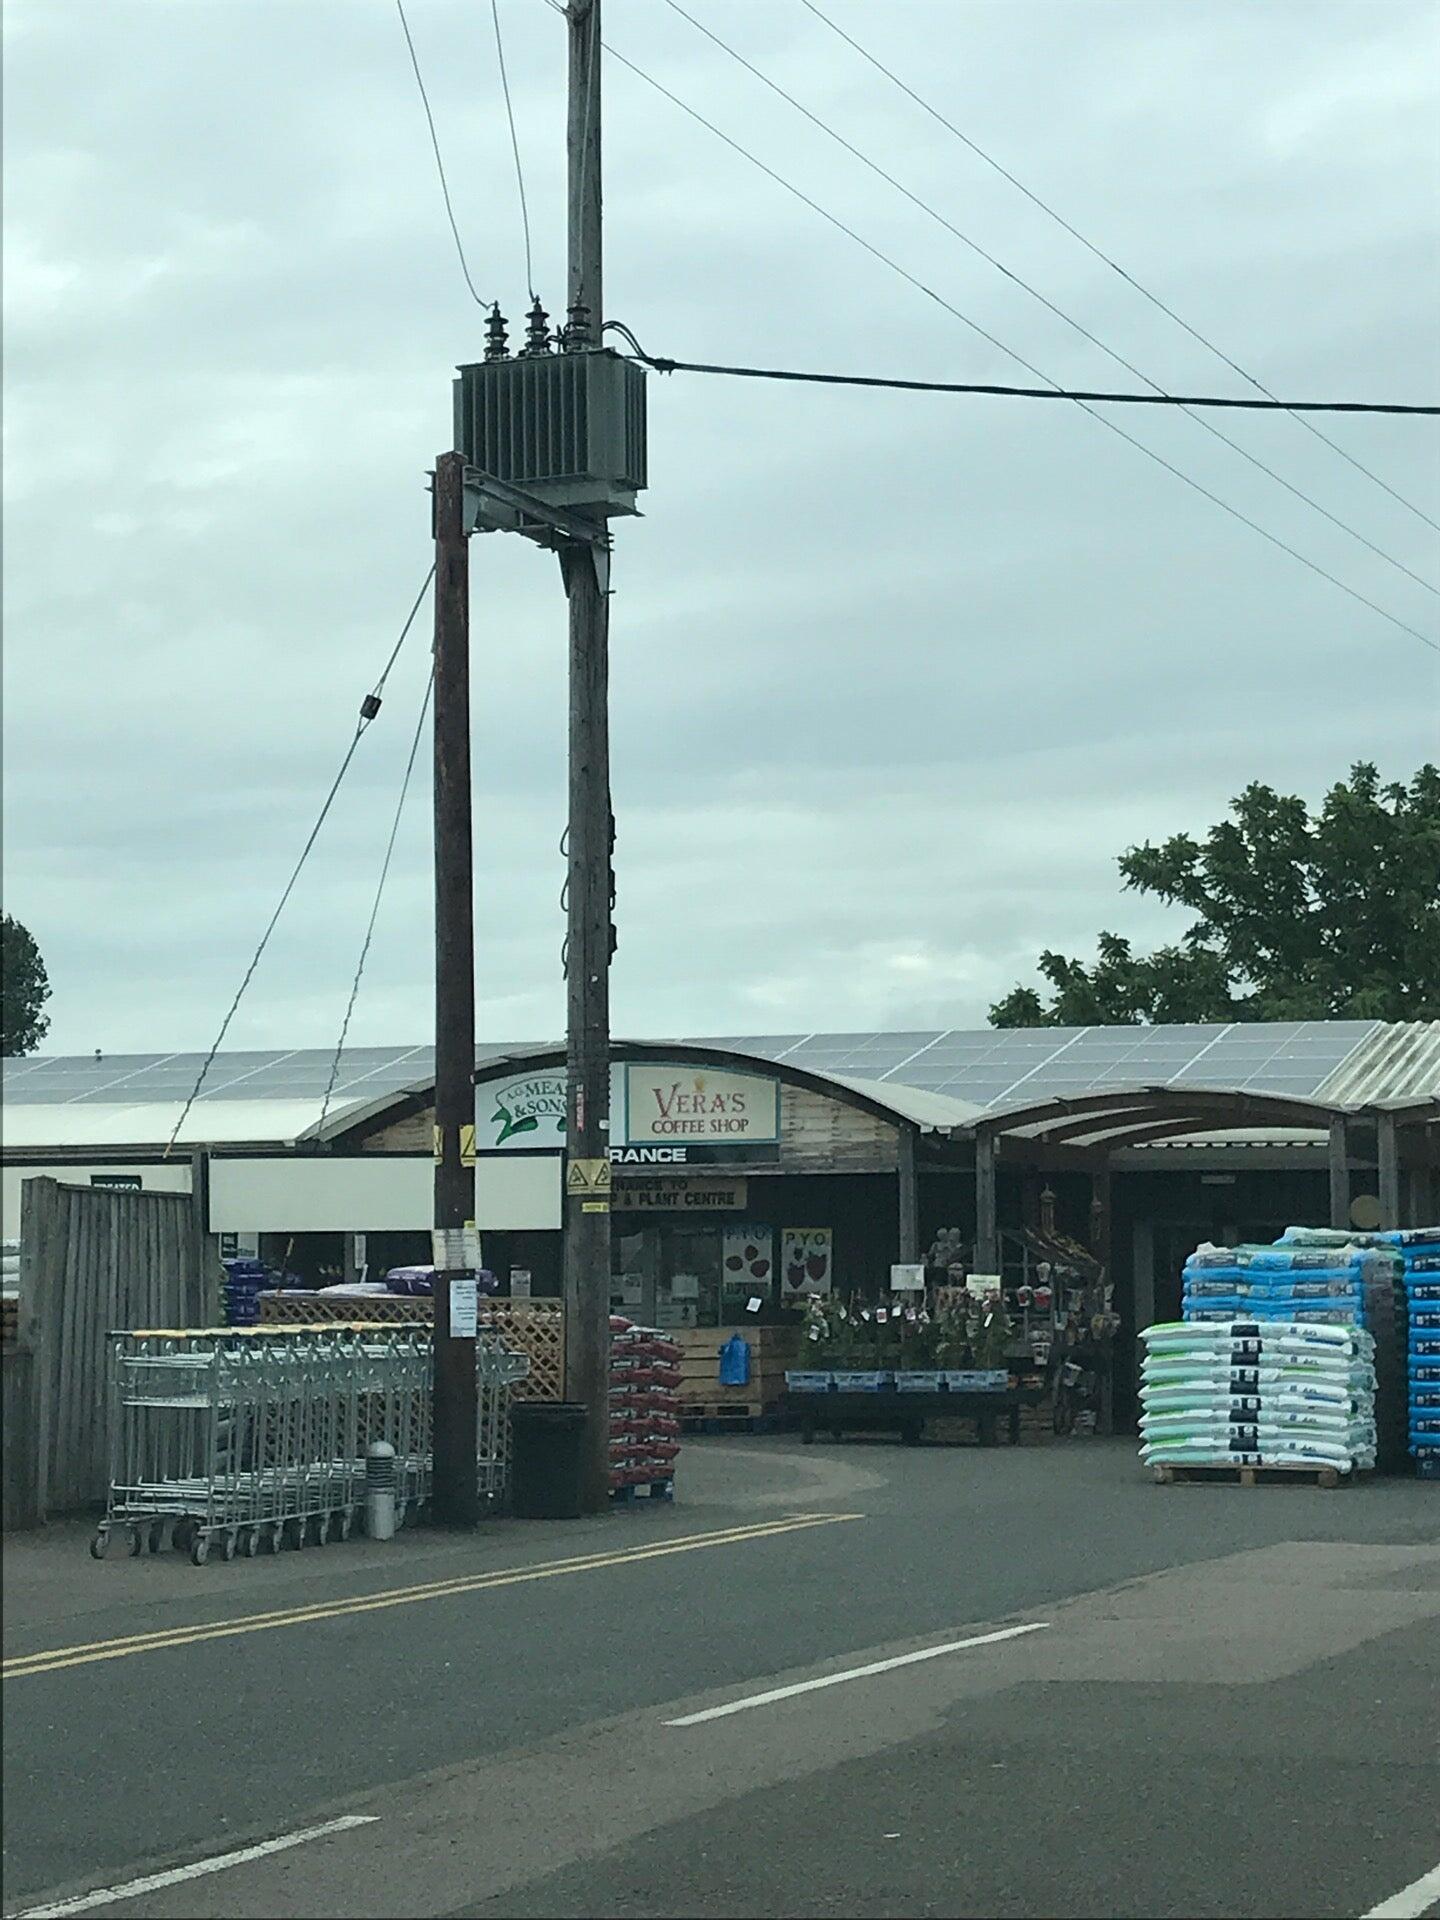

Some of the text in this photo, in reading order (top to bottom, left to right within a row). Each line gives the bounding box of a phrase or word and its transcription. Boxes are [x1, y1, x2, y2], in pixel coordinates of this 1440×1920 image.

[525, 1081, 567, 1097] MEA
[651, 1081, 745, 1118] VERA'S
[651, 1118, 749, 1134] COFFEE SHOP
[639, 1192, 679, 1206] PLANT
[684, 1192, 735, 1206] CENTRE
